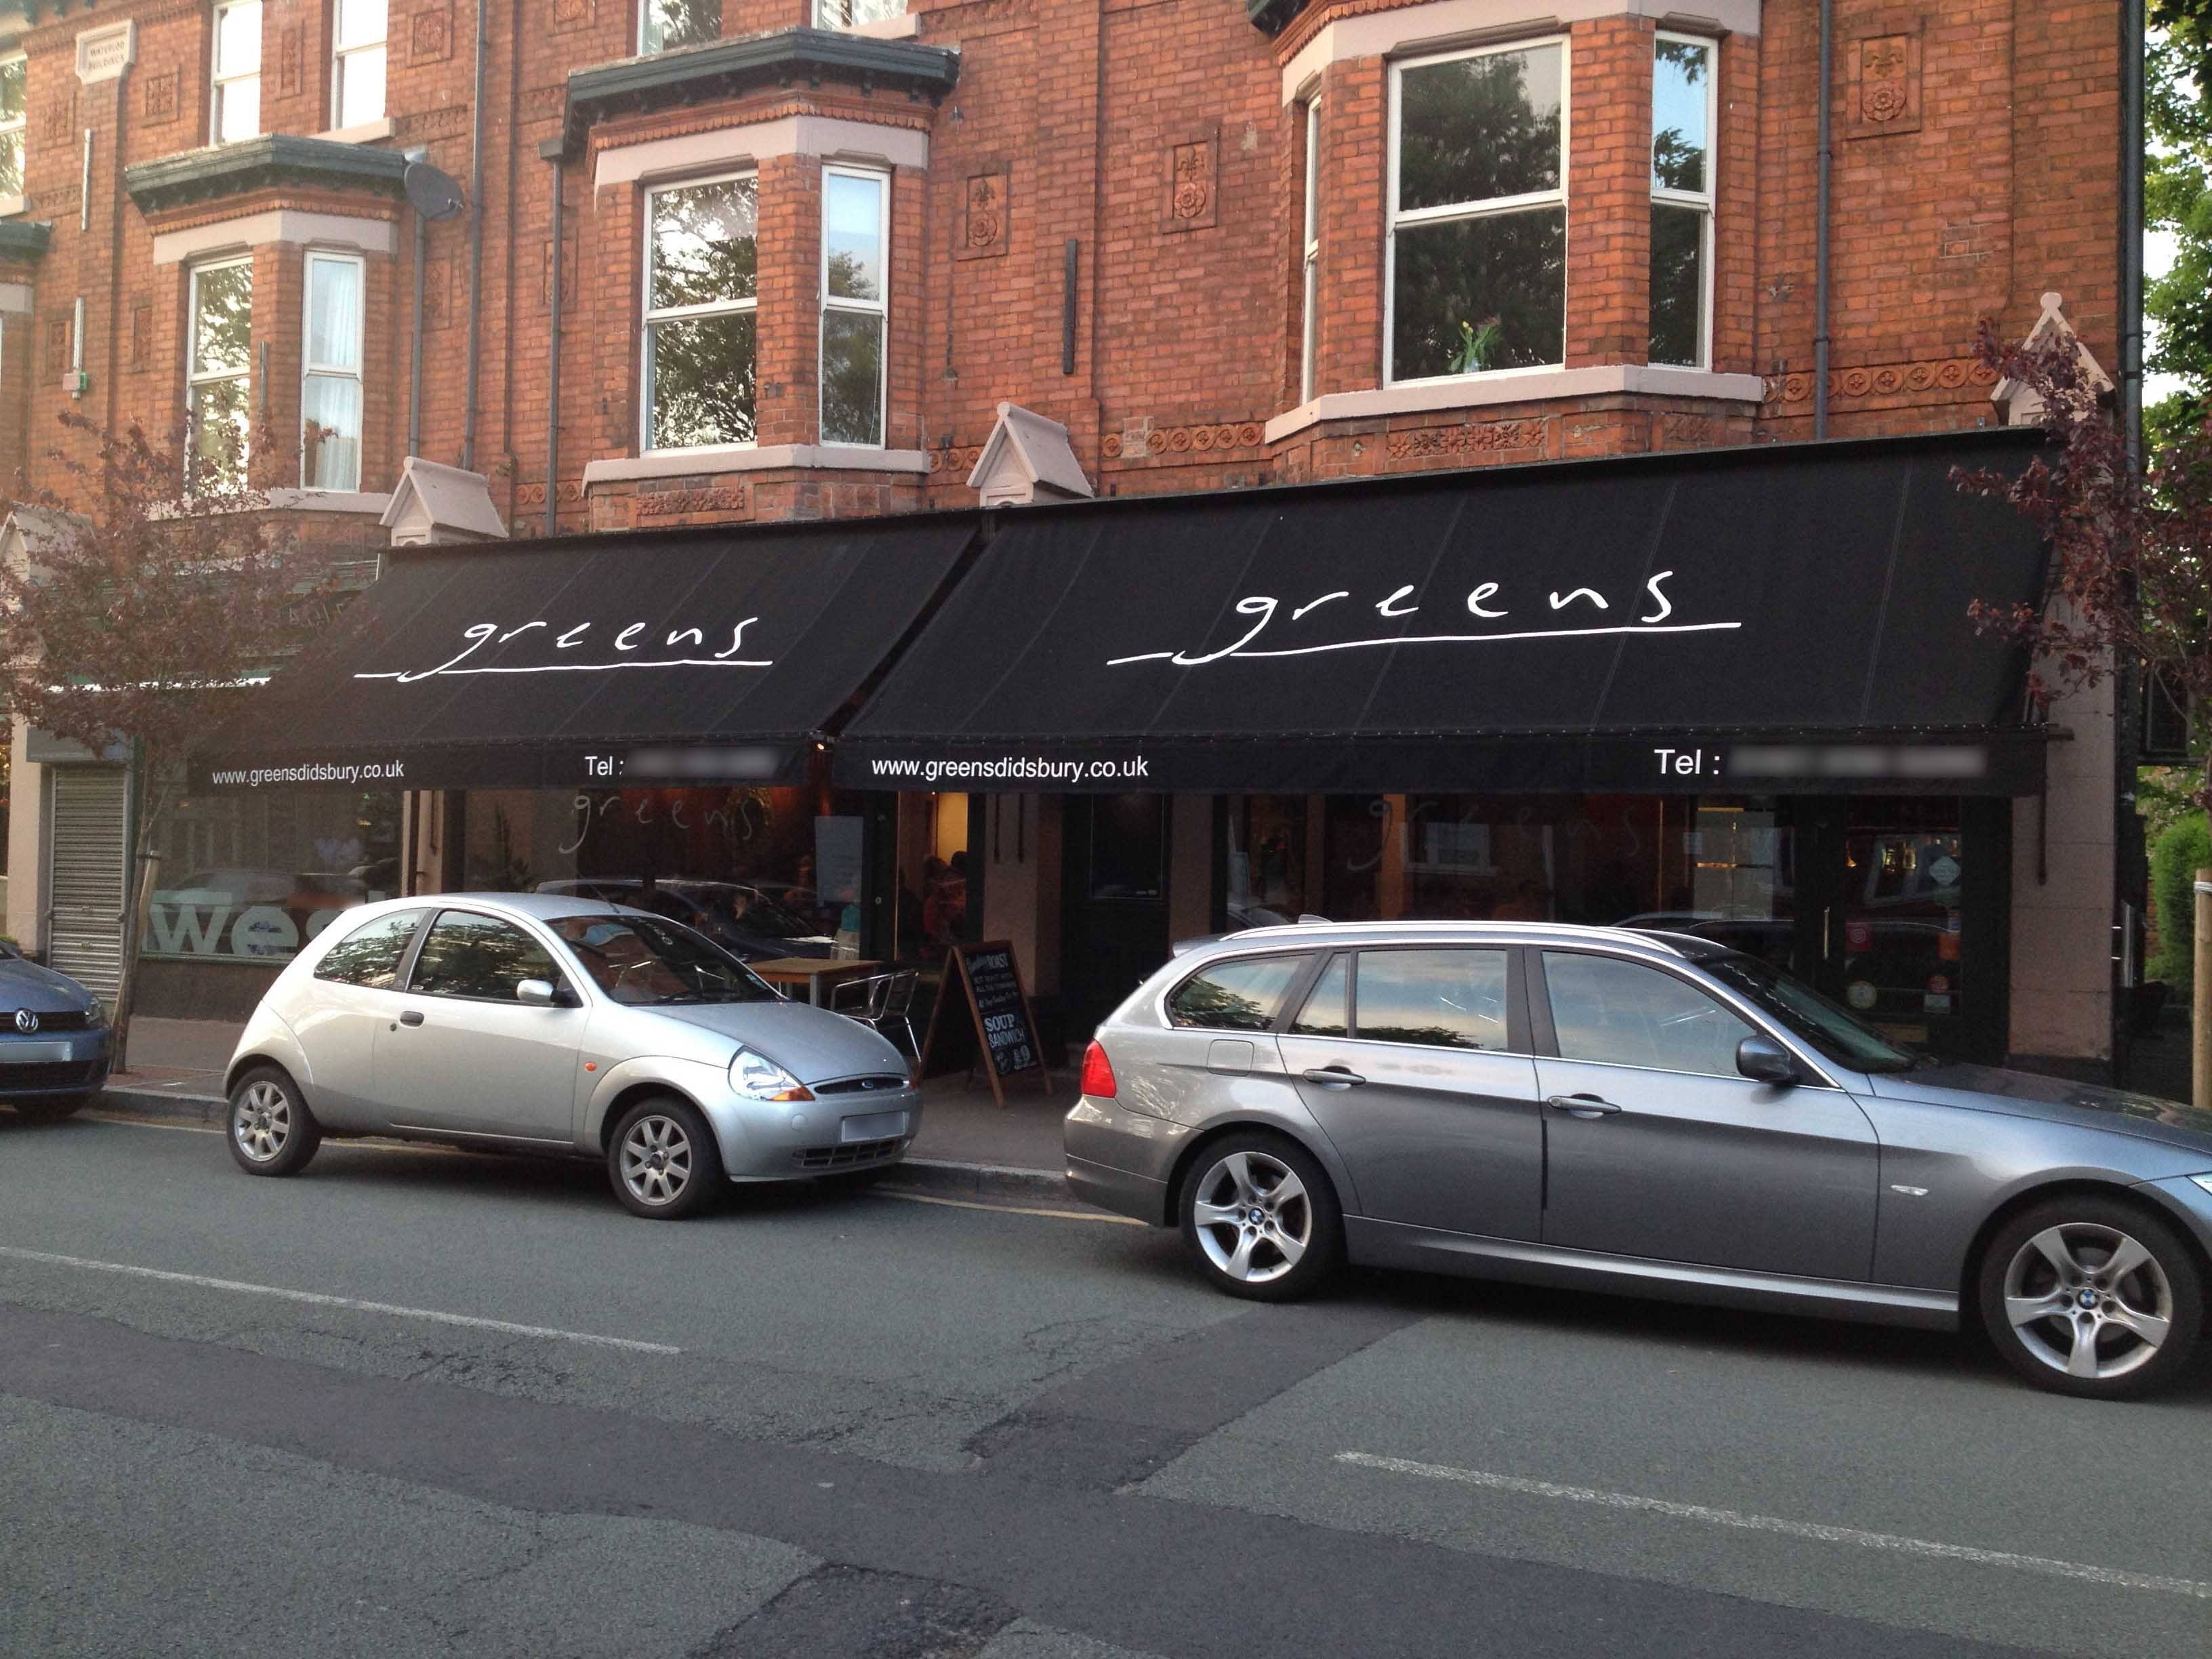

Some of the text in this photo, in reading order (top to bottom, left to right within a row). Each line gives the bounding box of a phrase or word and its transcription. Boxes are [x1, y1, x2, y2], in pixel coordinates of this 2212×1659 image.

[1172, 571, 1674, 665] greens
[396, 617, 758, 682] greens
[211, 759, 405, 787] www.greensdidsbury.co.uk
[872, 755, 1149, 783] www.greensdidsbury.co.uk
[984, 1013, 1015, 1032] SOUP
